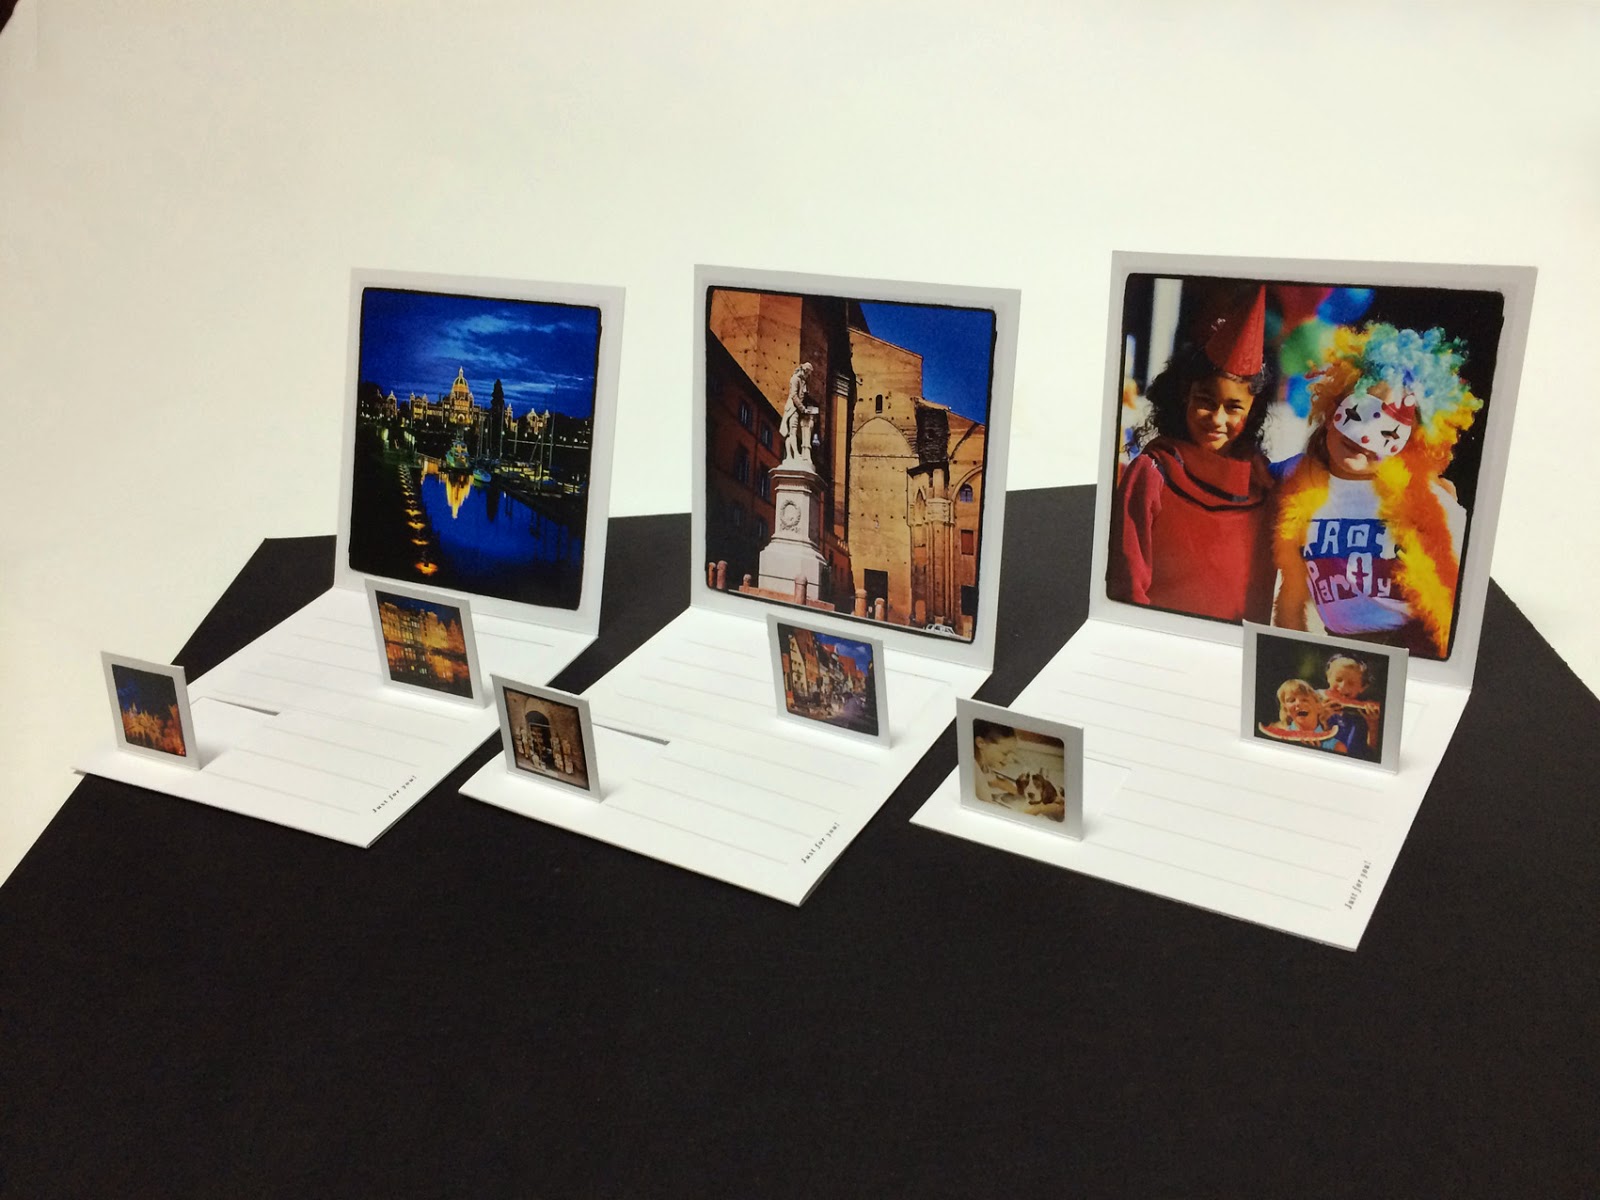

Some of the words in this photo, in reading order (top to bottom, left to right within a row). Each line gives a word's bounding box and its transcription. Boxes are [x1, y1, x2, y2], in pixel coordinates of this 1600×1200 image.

[801, 848, 816, 863] Just
[814, 837, 825, 849] for
[1344, 892, 1358, 910] Just
[1352, 879, 1363, 893] for
